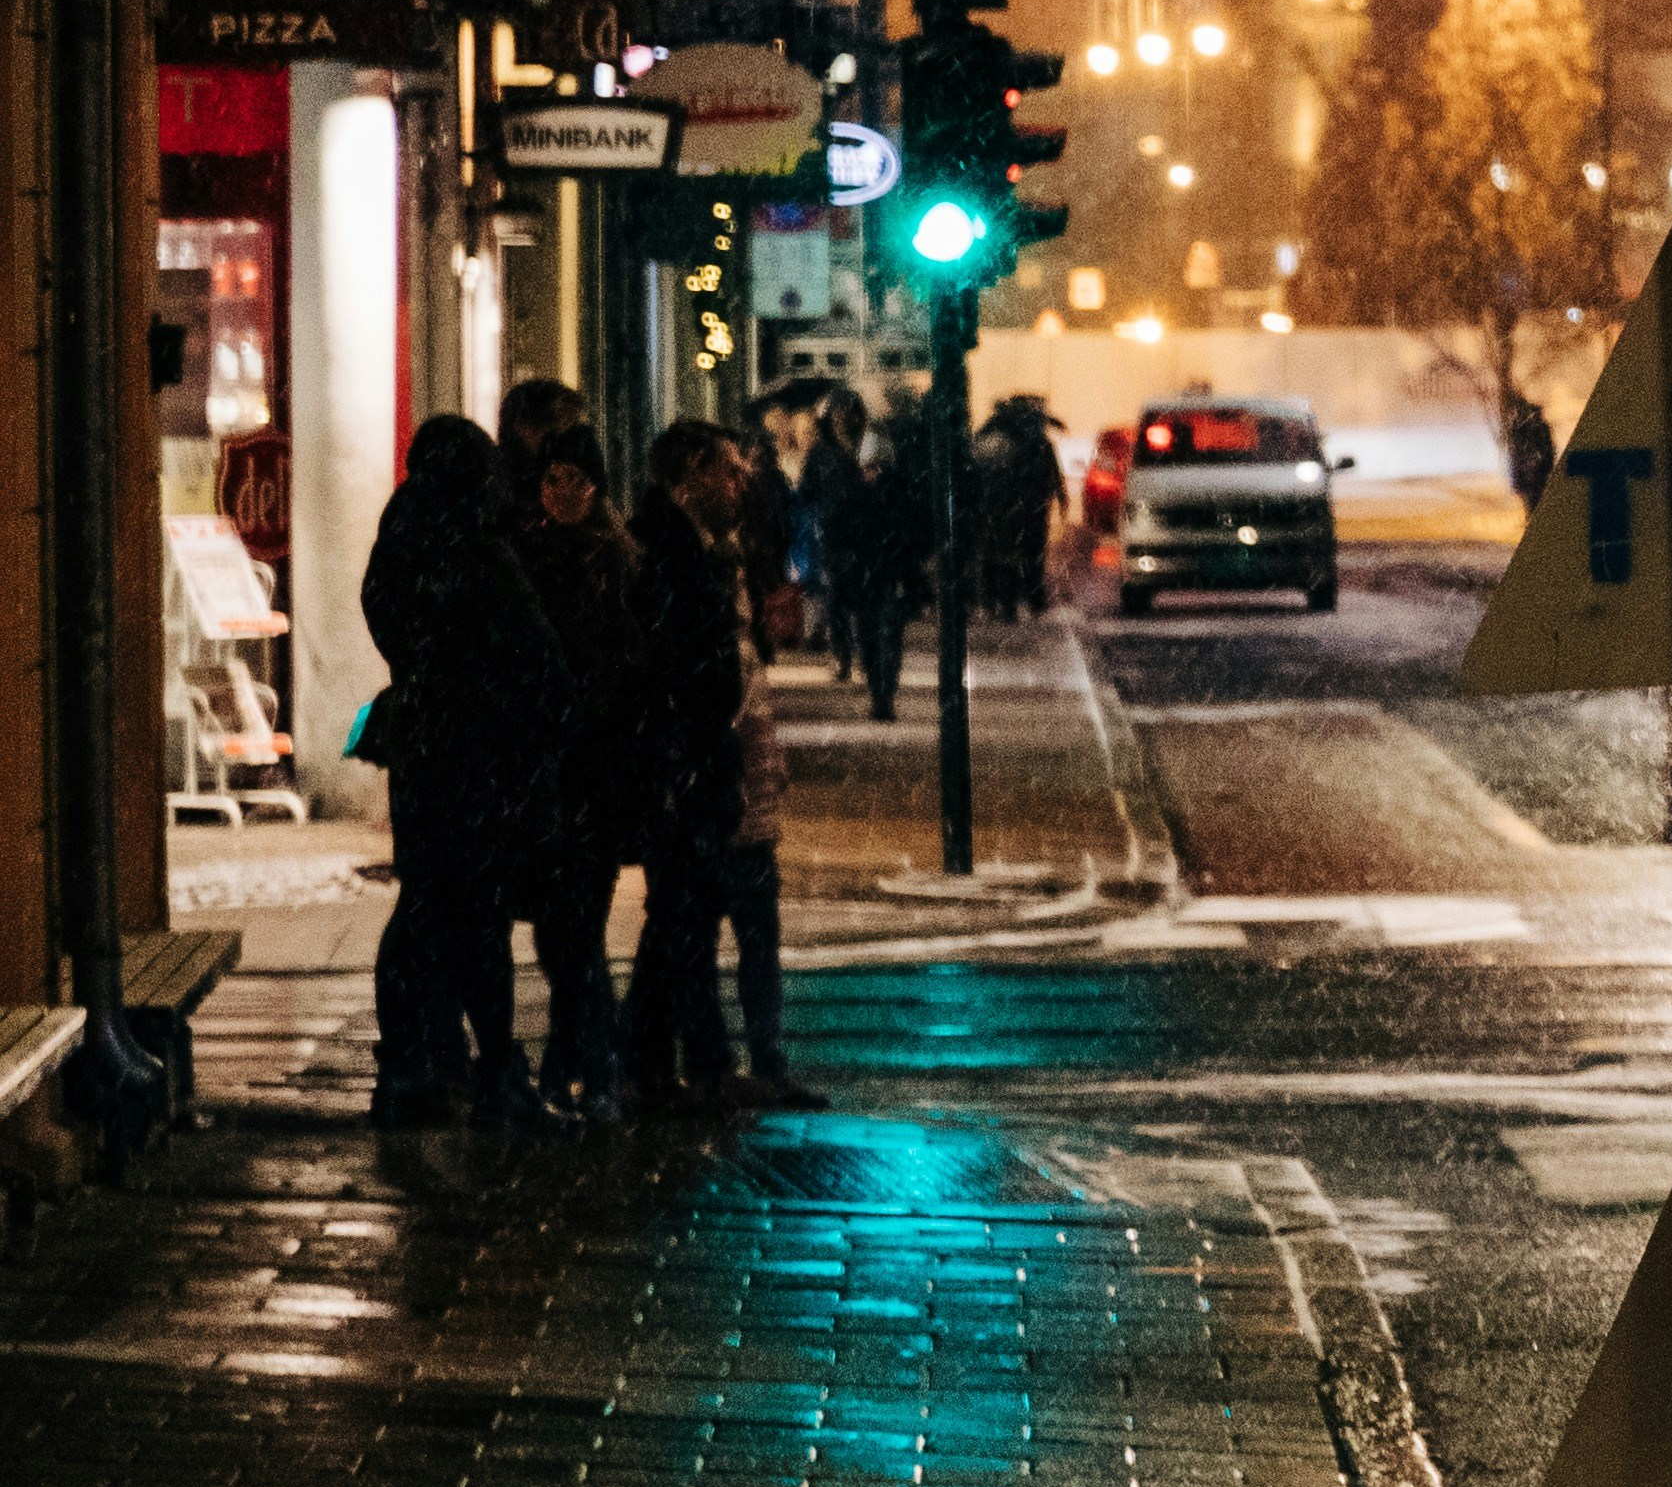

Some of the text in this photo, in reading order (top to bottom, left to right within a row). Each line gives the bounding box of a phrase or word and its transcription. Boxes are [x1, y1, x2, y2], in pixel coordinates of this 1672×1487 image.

[209, 11, 337, 45] PIZZA
[512, 122, 653, 150] MINIBANK
[236, 453, 286, 533] del
